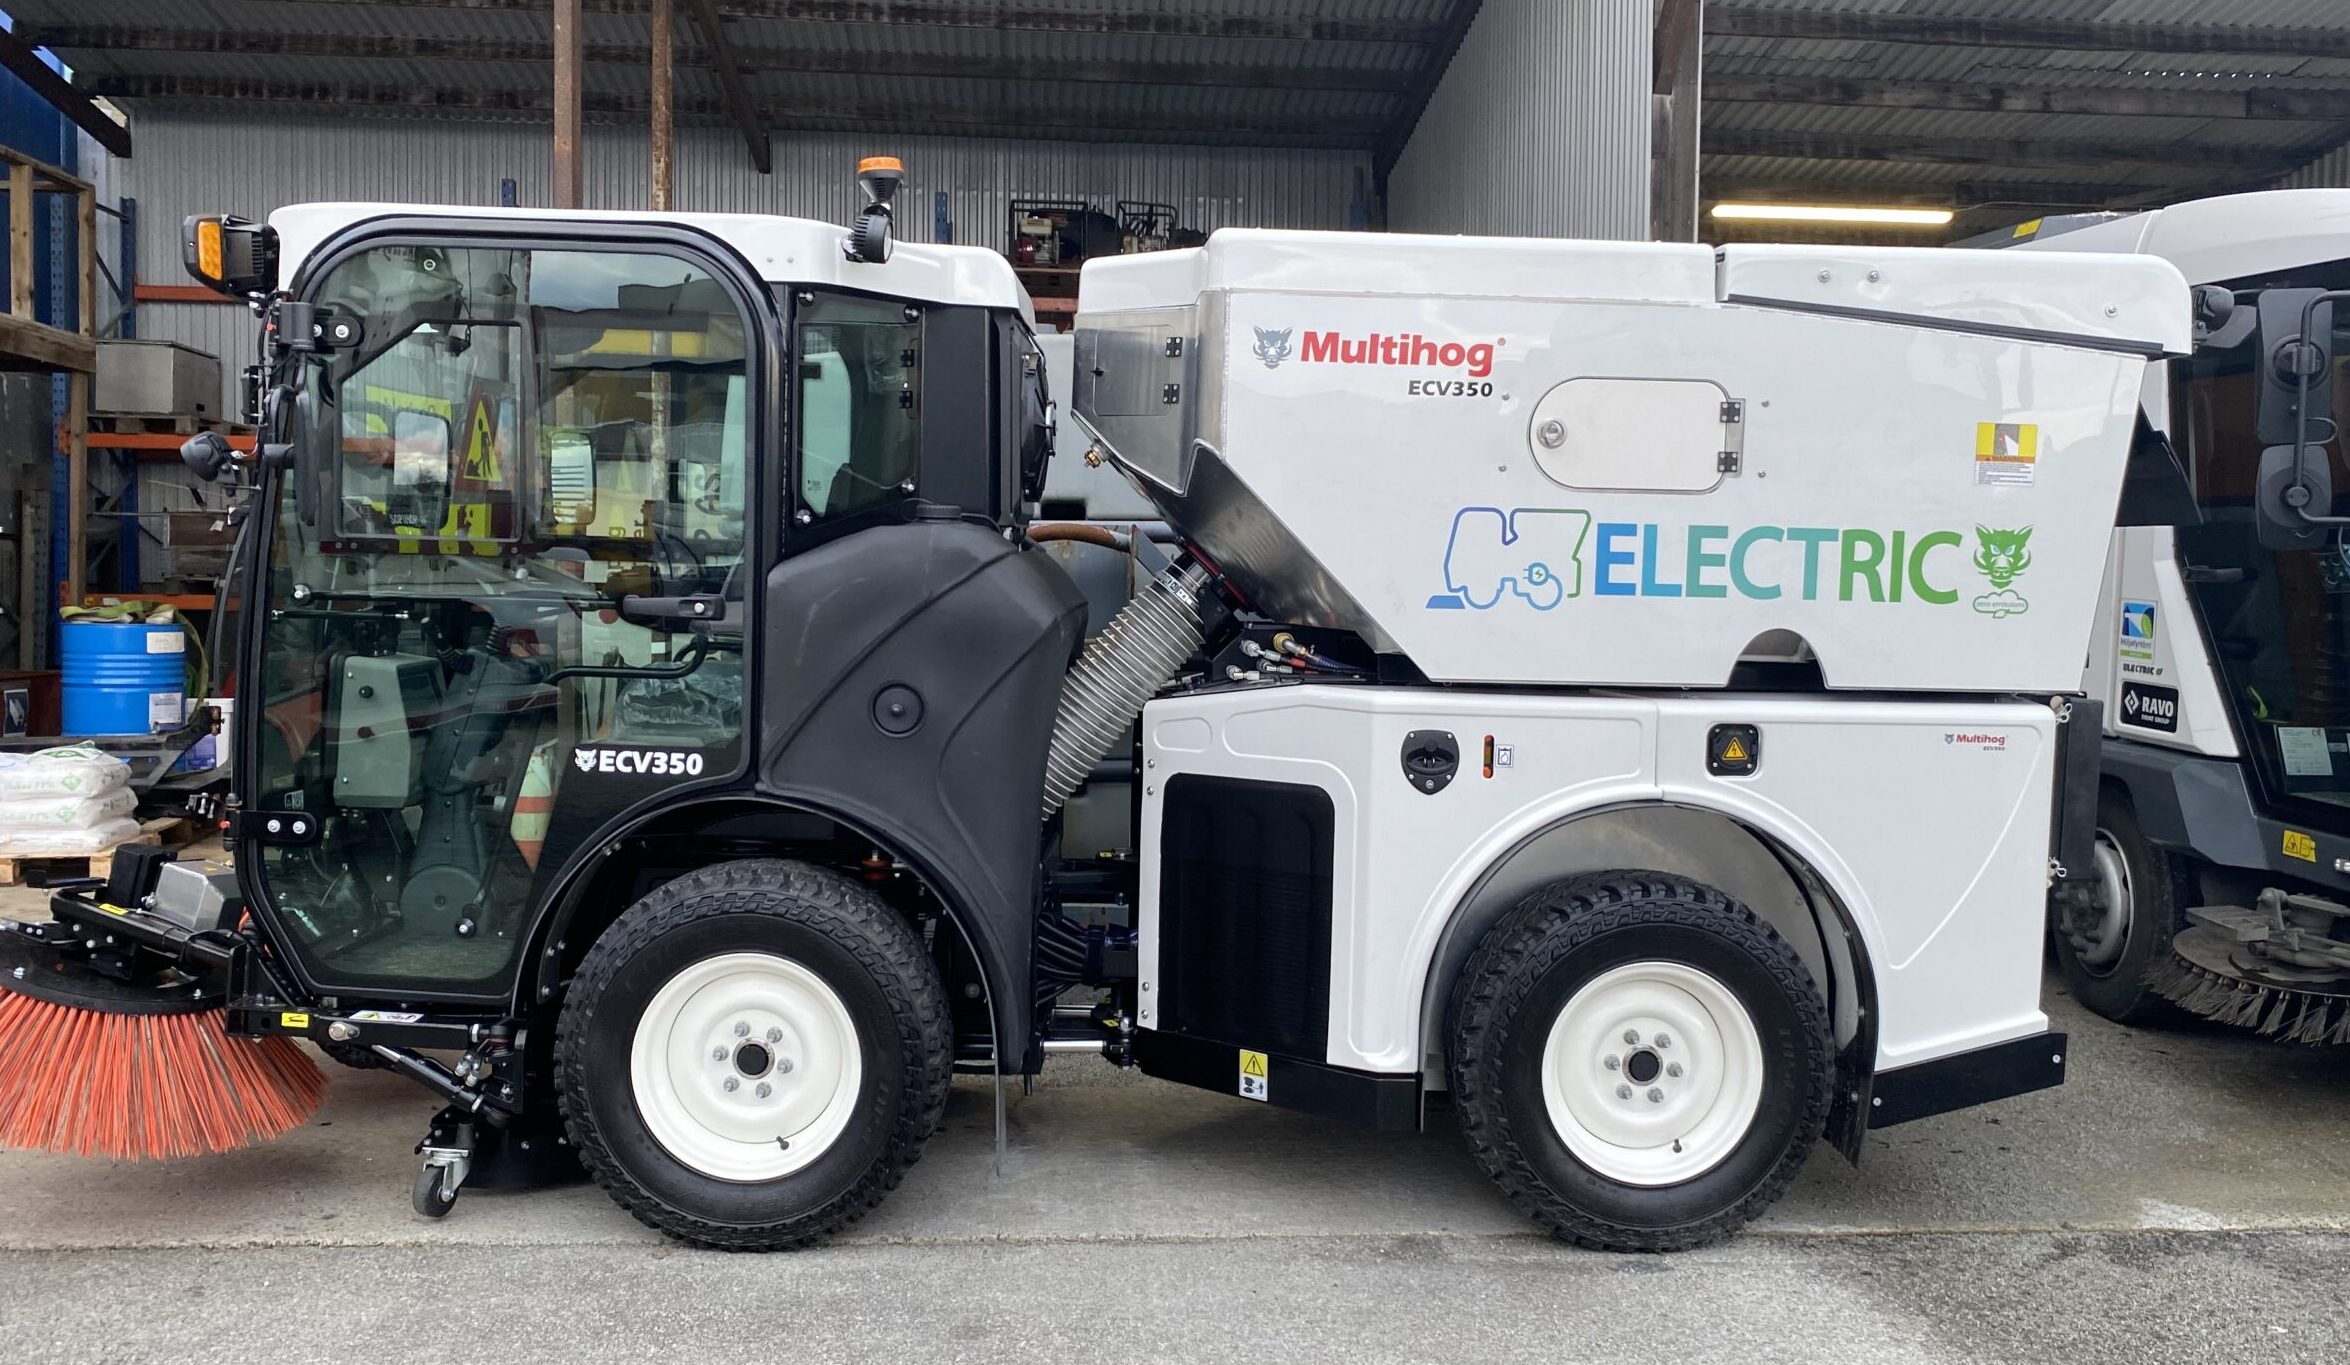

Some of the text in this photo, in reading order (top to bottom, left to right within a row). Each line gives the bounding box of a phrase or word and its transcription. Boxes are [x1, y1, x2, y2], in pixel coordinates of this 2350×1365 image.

[1300, 331, 1494, 377] Multihog
[1408, 380, 1493, 397] ECV350
[1594, 523, 1963, 604] ELECTRIC
[2123, 663, 2155, 675] ELECTRIC
[2141, 696, 2174, 717] RAVO
[1956, 734, 2005, 745] Multihog
[599, 750, 703, 775] ECV350
